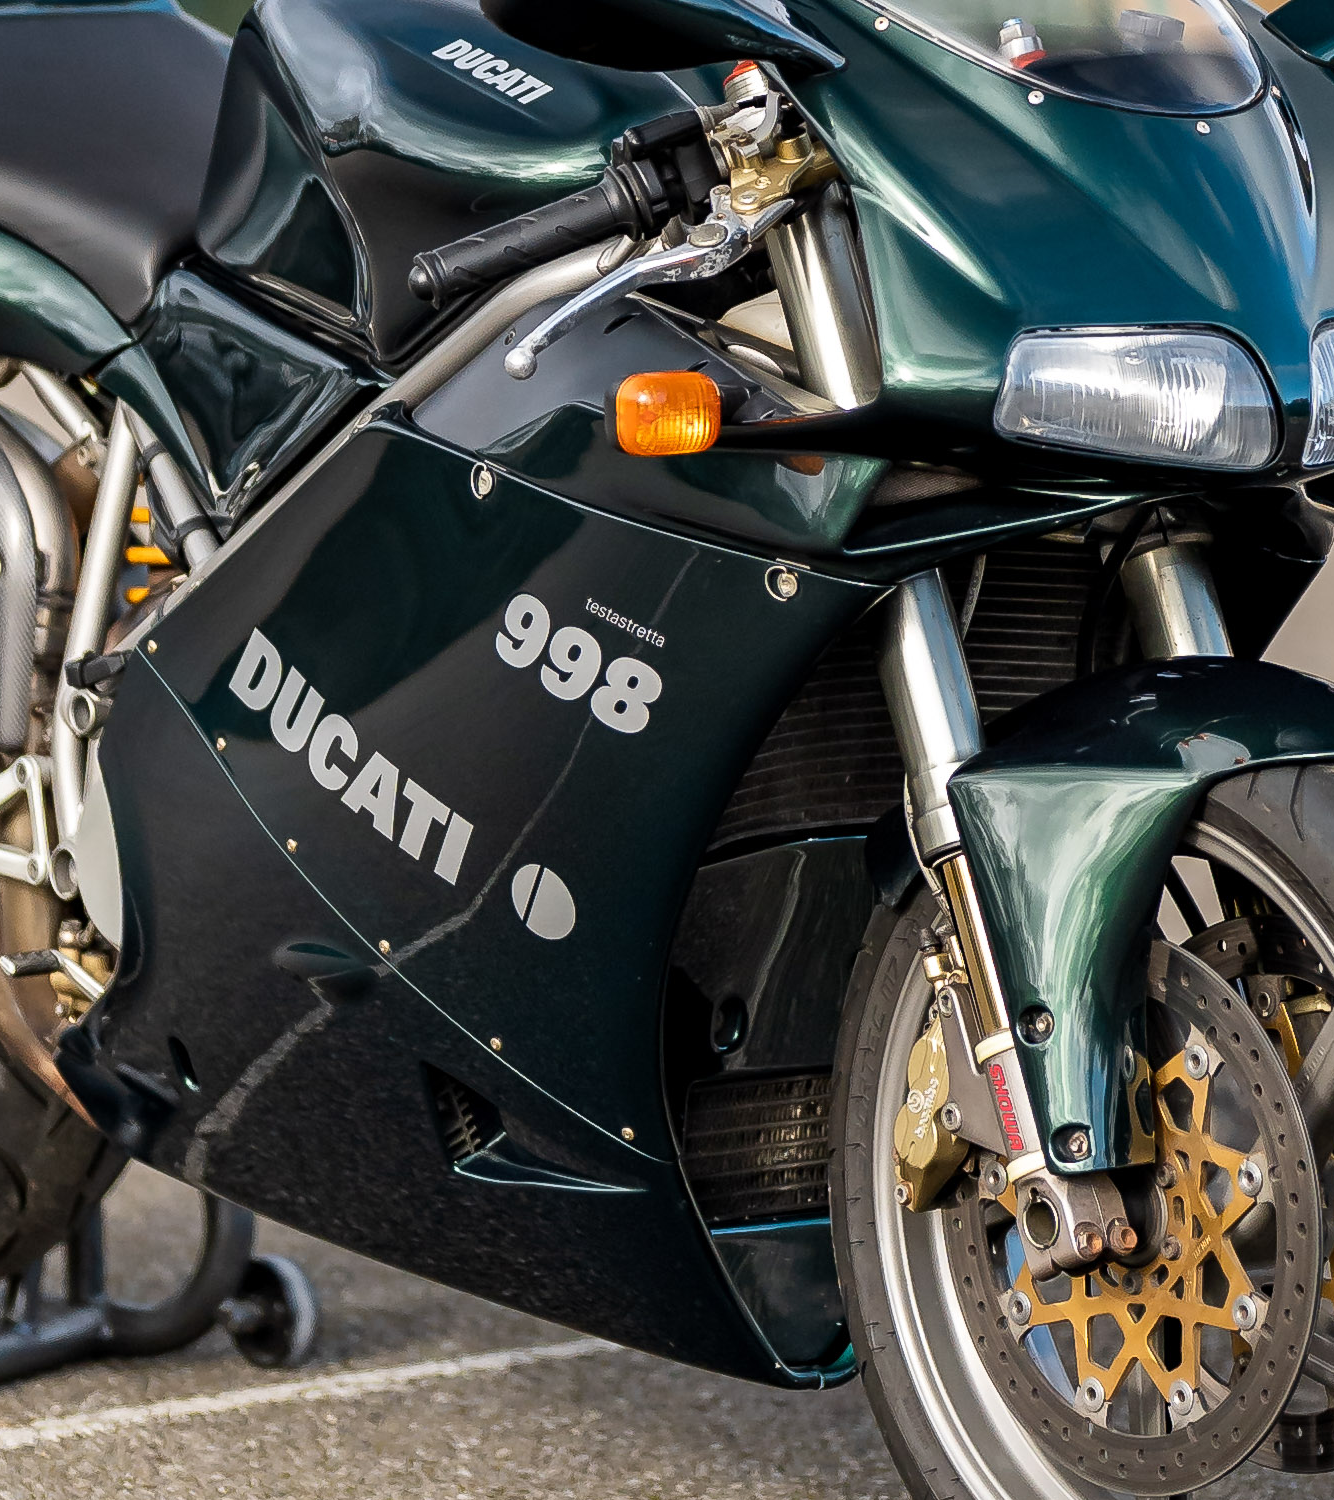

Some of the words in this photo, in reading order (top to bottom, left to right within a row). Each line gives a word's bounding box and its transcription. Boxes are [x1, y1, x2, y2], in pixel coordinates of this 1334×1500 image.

[431, 38, 554, 105] DUCATI
[585, 597, 666, 648] testastretta
[495, 593, 663, 734] 998
[228, 626, 474, 886] DUCATI
[913, 1077, 939, 1139] brembo
[987, 1063, 1025, 1151] SHOWA
